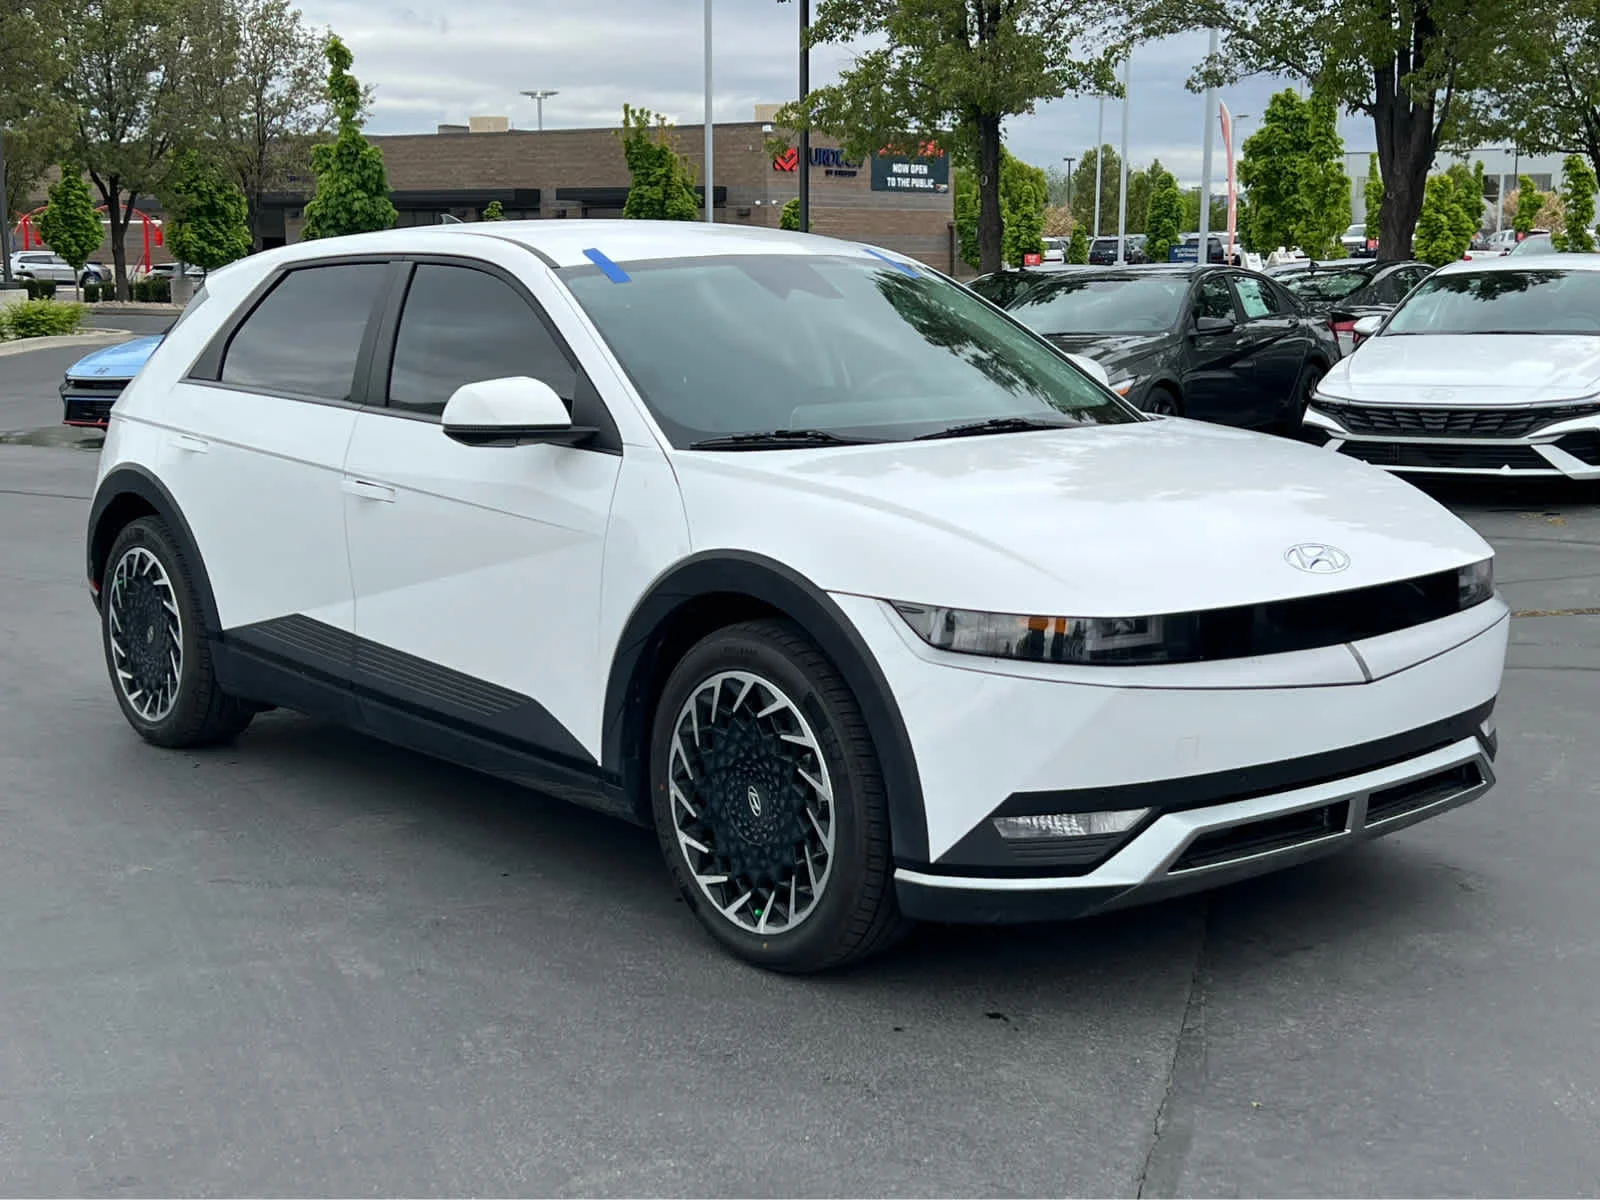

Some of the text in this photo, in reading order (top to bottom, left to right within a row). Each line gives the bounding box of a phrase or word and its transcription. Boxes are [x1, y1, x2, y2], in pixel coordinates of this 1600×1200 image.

[892, 163, 928, 175] NOW OPEN
[886, 177, 896, 187] TO
[897, 177, 910, 188] THE
[911, 178, 934, 189] PUBLIC
